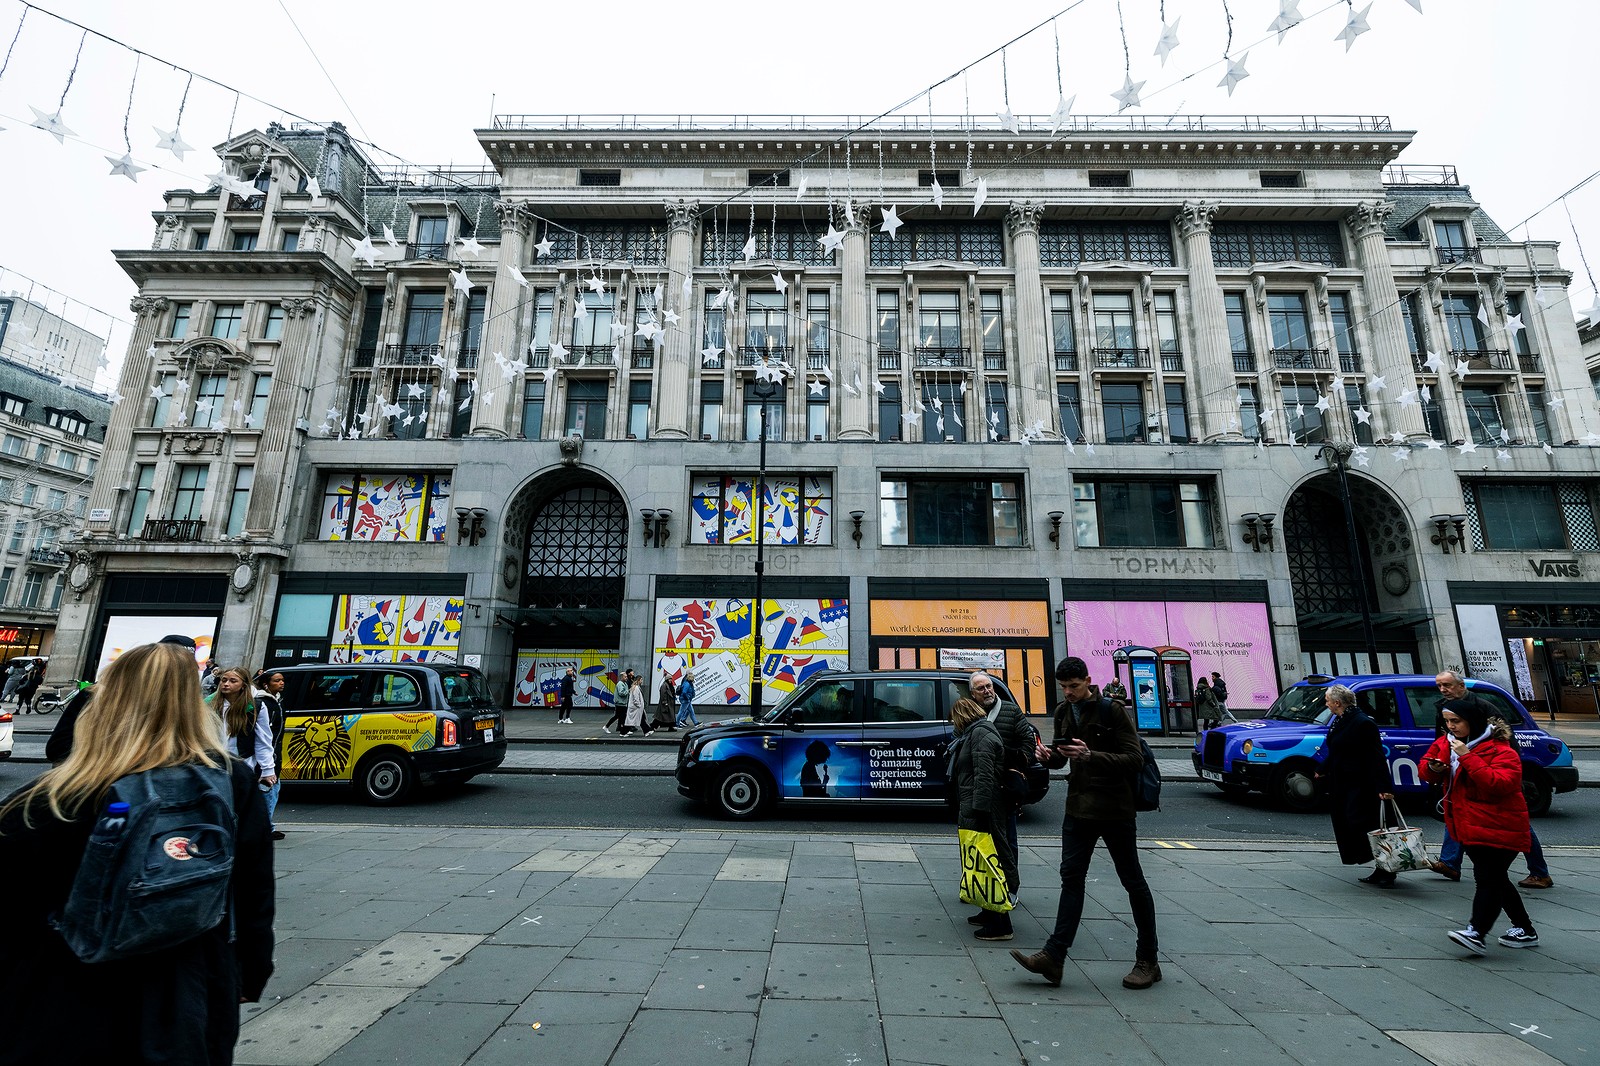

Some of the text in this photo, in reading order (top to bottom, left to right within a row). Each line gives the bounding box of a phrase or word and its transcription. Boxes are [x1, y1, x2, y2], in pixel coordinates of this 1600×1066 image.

[707, 554, 800, 570] TOPSHOP
[1110, 557, 1215, 574] TOPMAN
[1529, 559, 1581, 577] VANS
[890, 625, 912, 633] world
[931, 626, 964, 634] FLAGSHIP
[988, 627, 1031, 637] opportunity
[1117, 639, 1133, 647] 218
[1188, 640, 1208, 648] world
[1207, 640, 1225, 648] class
[1213, 650, 1249, 658] opportunity
[1283, 663, 1295, 671] 216
[869, 747, 936, 759] Open the door
[869, 758, 922, 770] to amazing
[869, 768, 927, 780] experiences
[869, 779, 922, 789] with Amex
